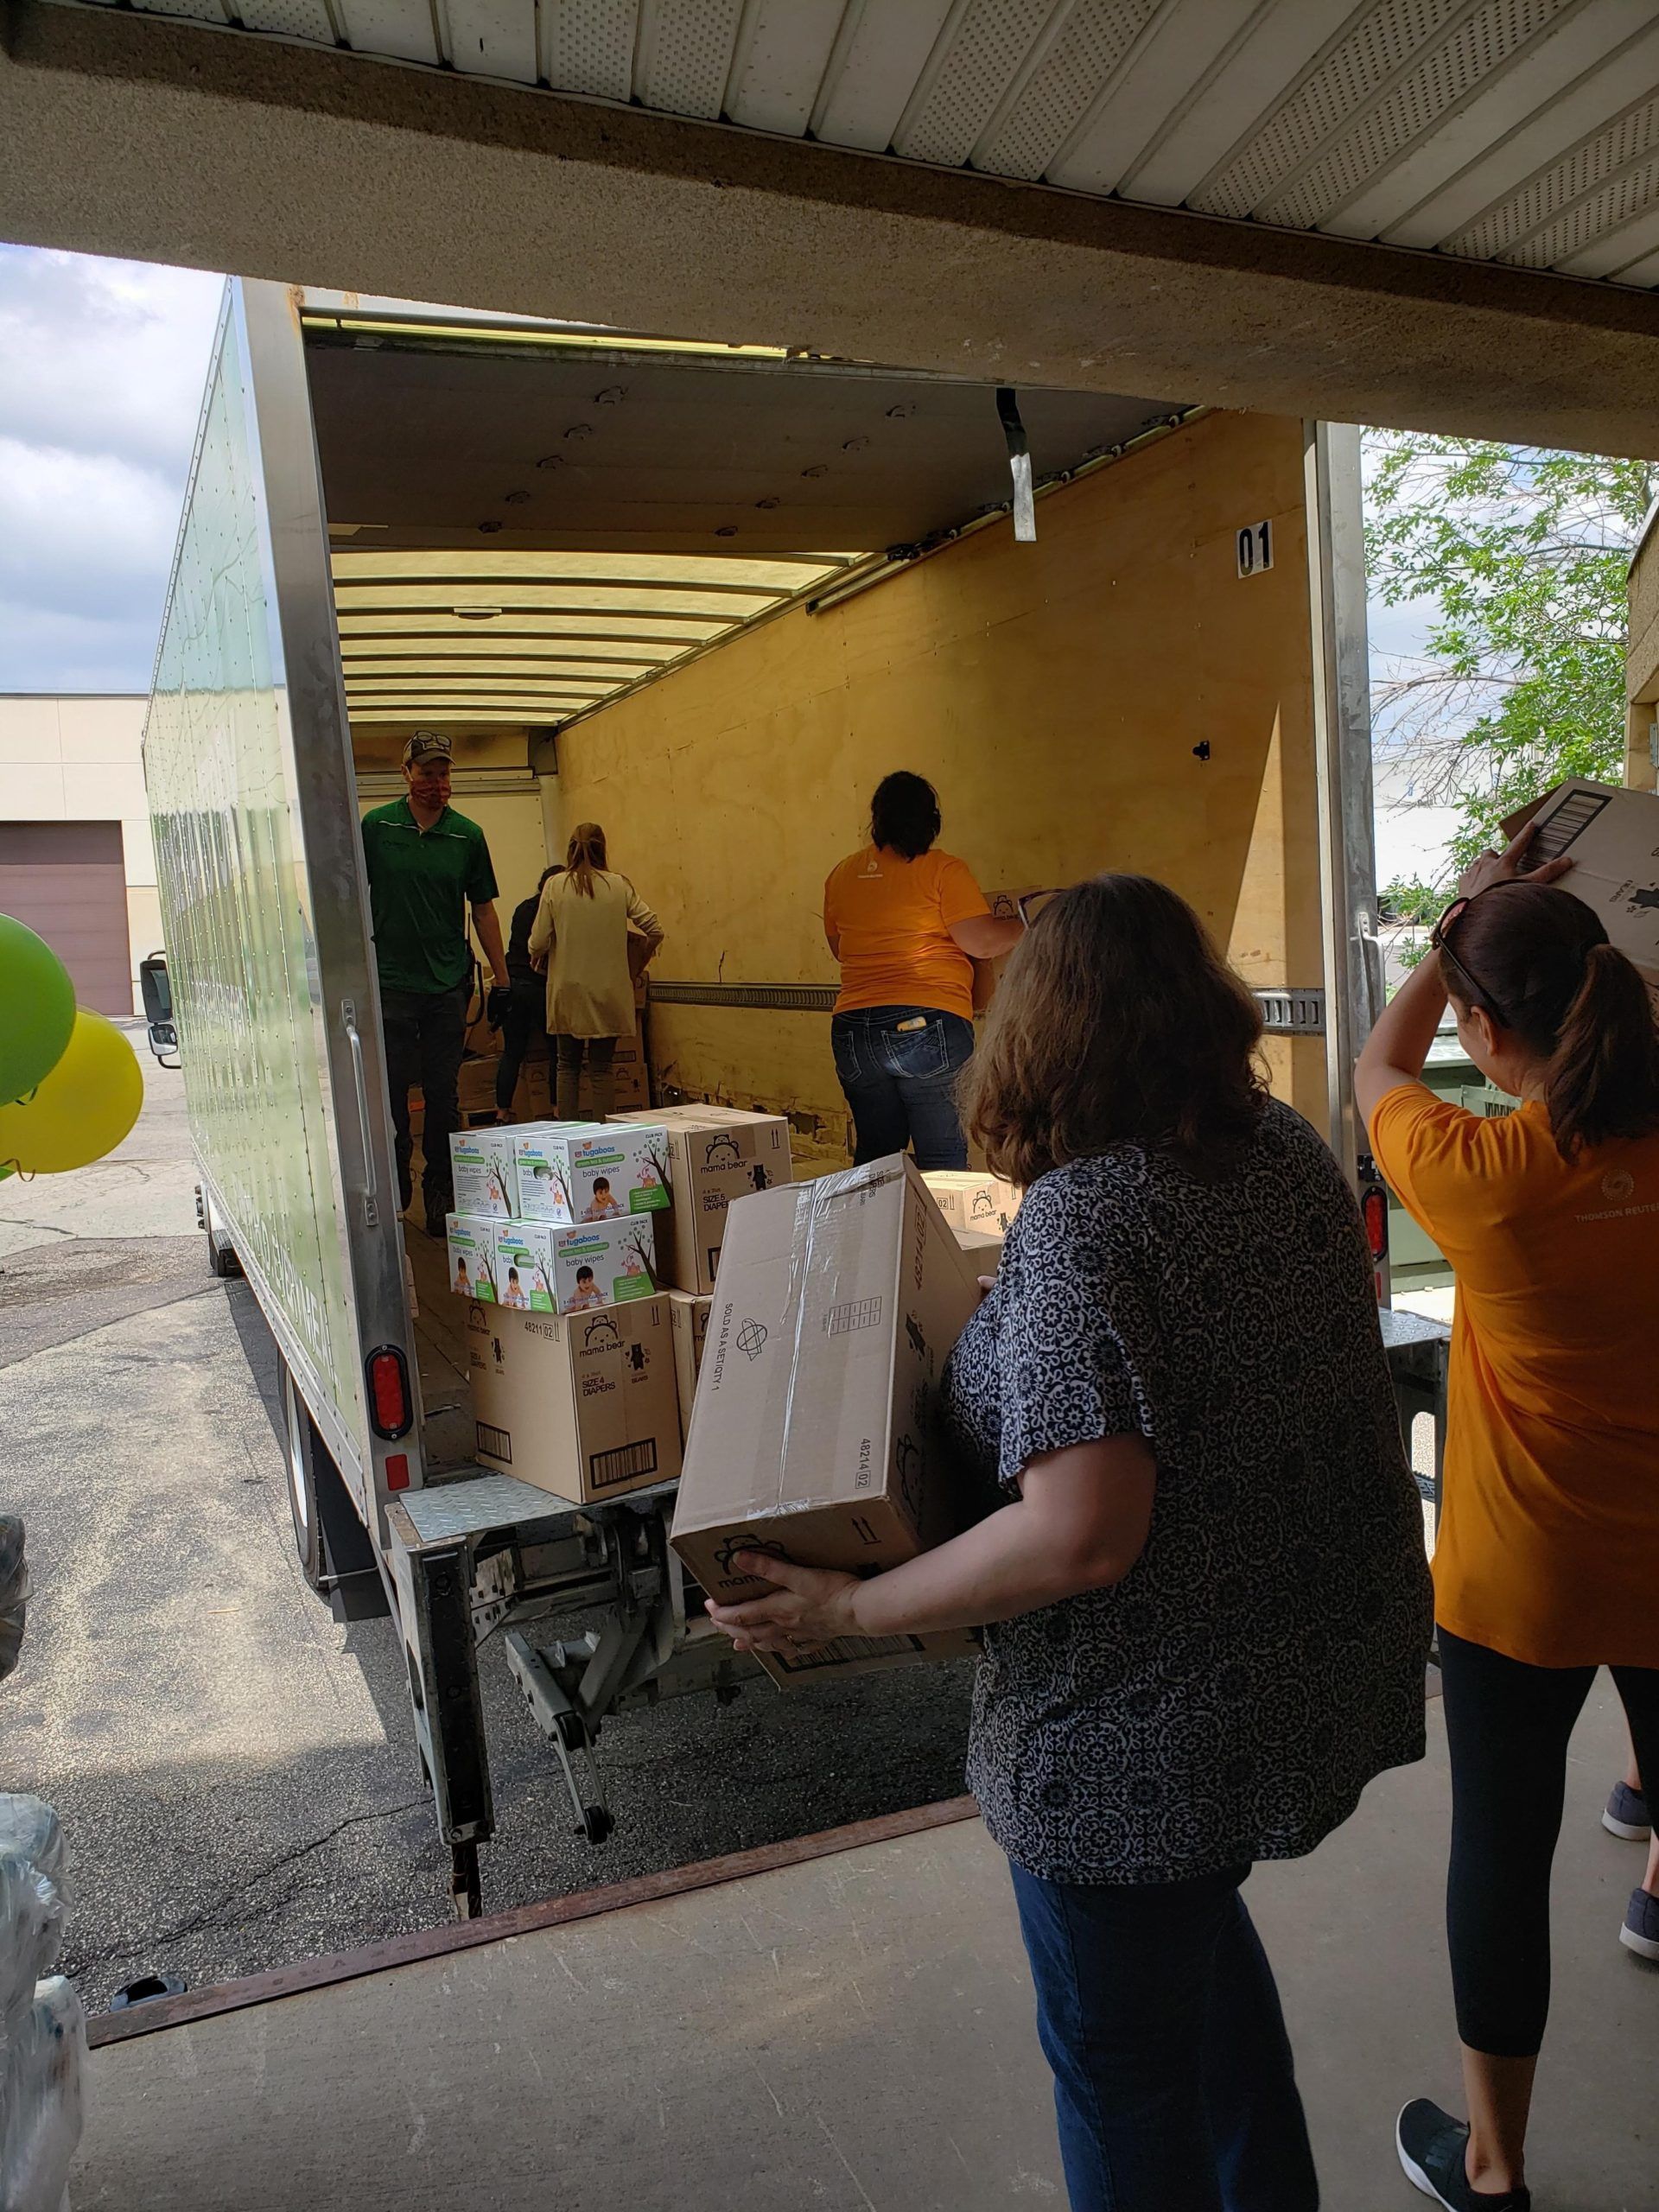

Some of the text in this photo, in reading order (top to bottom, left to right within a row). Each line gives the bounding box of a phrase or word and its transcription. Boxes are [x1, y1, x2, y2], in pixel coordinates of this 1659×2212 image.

[1239, 521, 1269, 575] 01
[582, 1146, 615, 1157] tugaboos
[701, 1160, 747, 1173] mama bear
[583, 1168, 600, 1178] baby
[703, 1194, 720, 1204] SIZE
[938, 1199, 947, 1208] 02
[1574, 1210, 1624, 1223] THOMSON
[567, 1234, 600, 1246] tugaboos
[566, 1255, 604, 1267] baby wipes
[722, 1303, 733, 1325] SOLD
[524, 1321, 553, 1338] 48211 02
[721, 1328, 729, 1338] AS
[580, 1339, 626, 1357] mama bear
[582, 1377, 599, 1389] SIZE
[583, 1382, 615, 1396] DIAPERS
[858, 1438, 871, 1486] 48214 02
